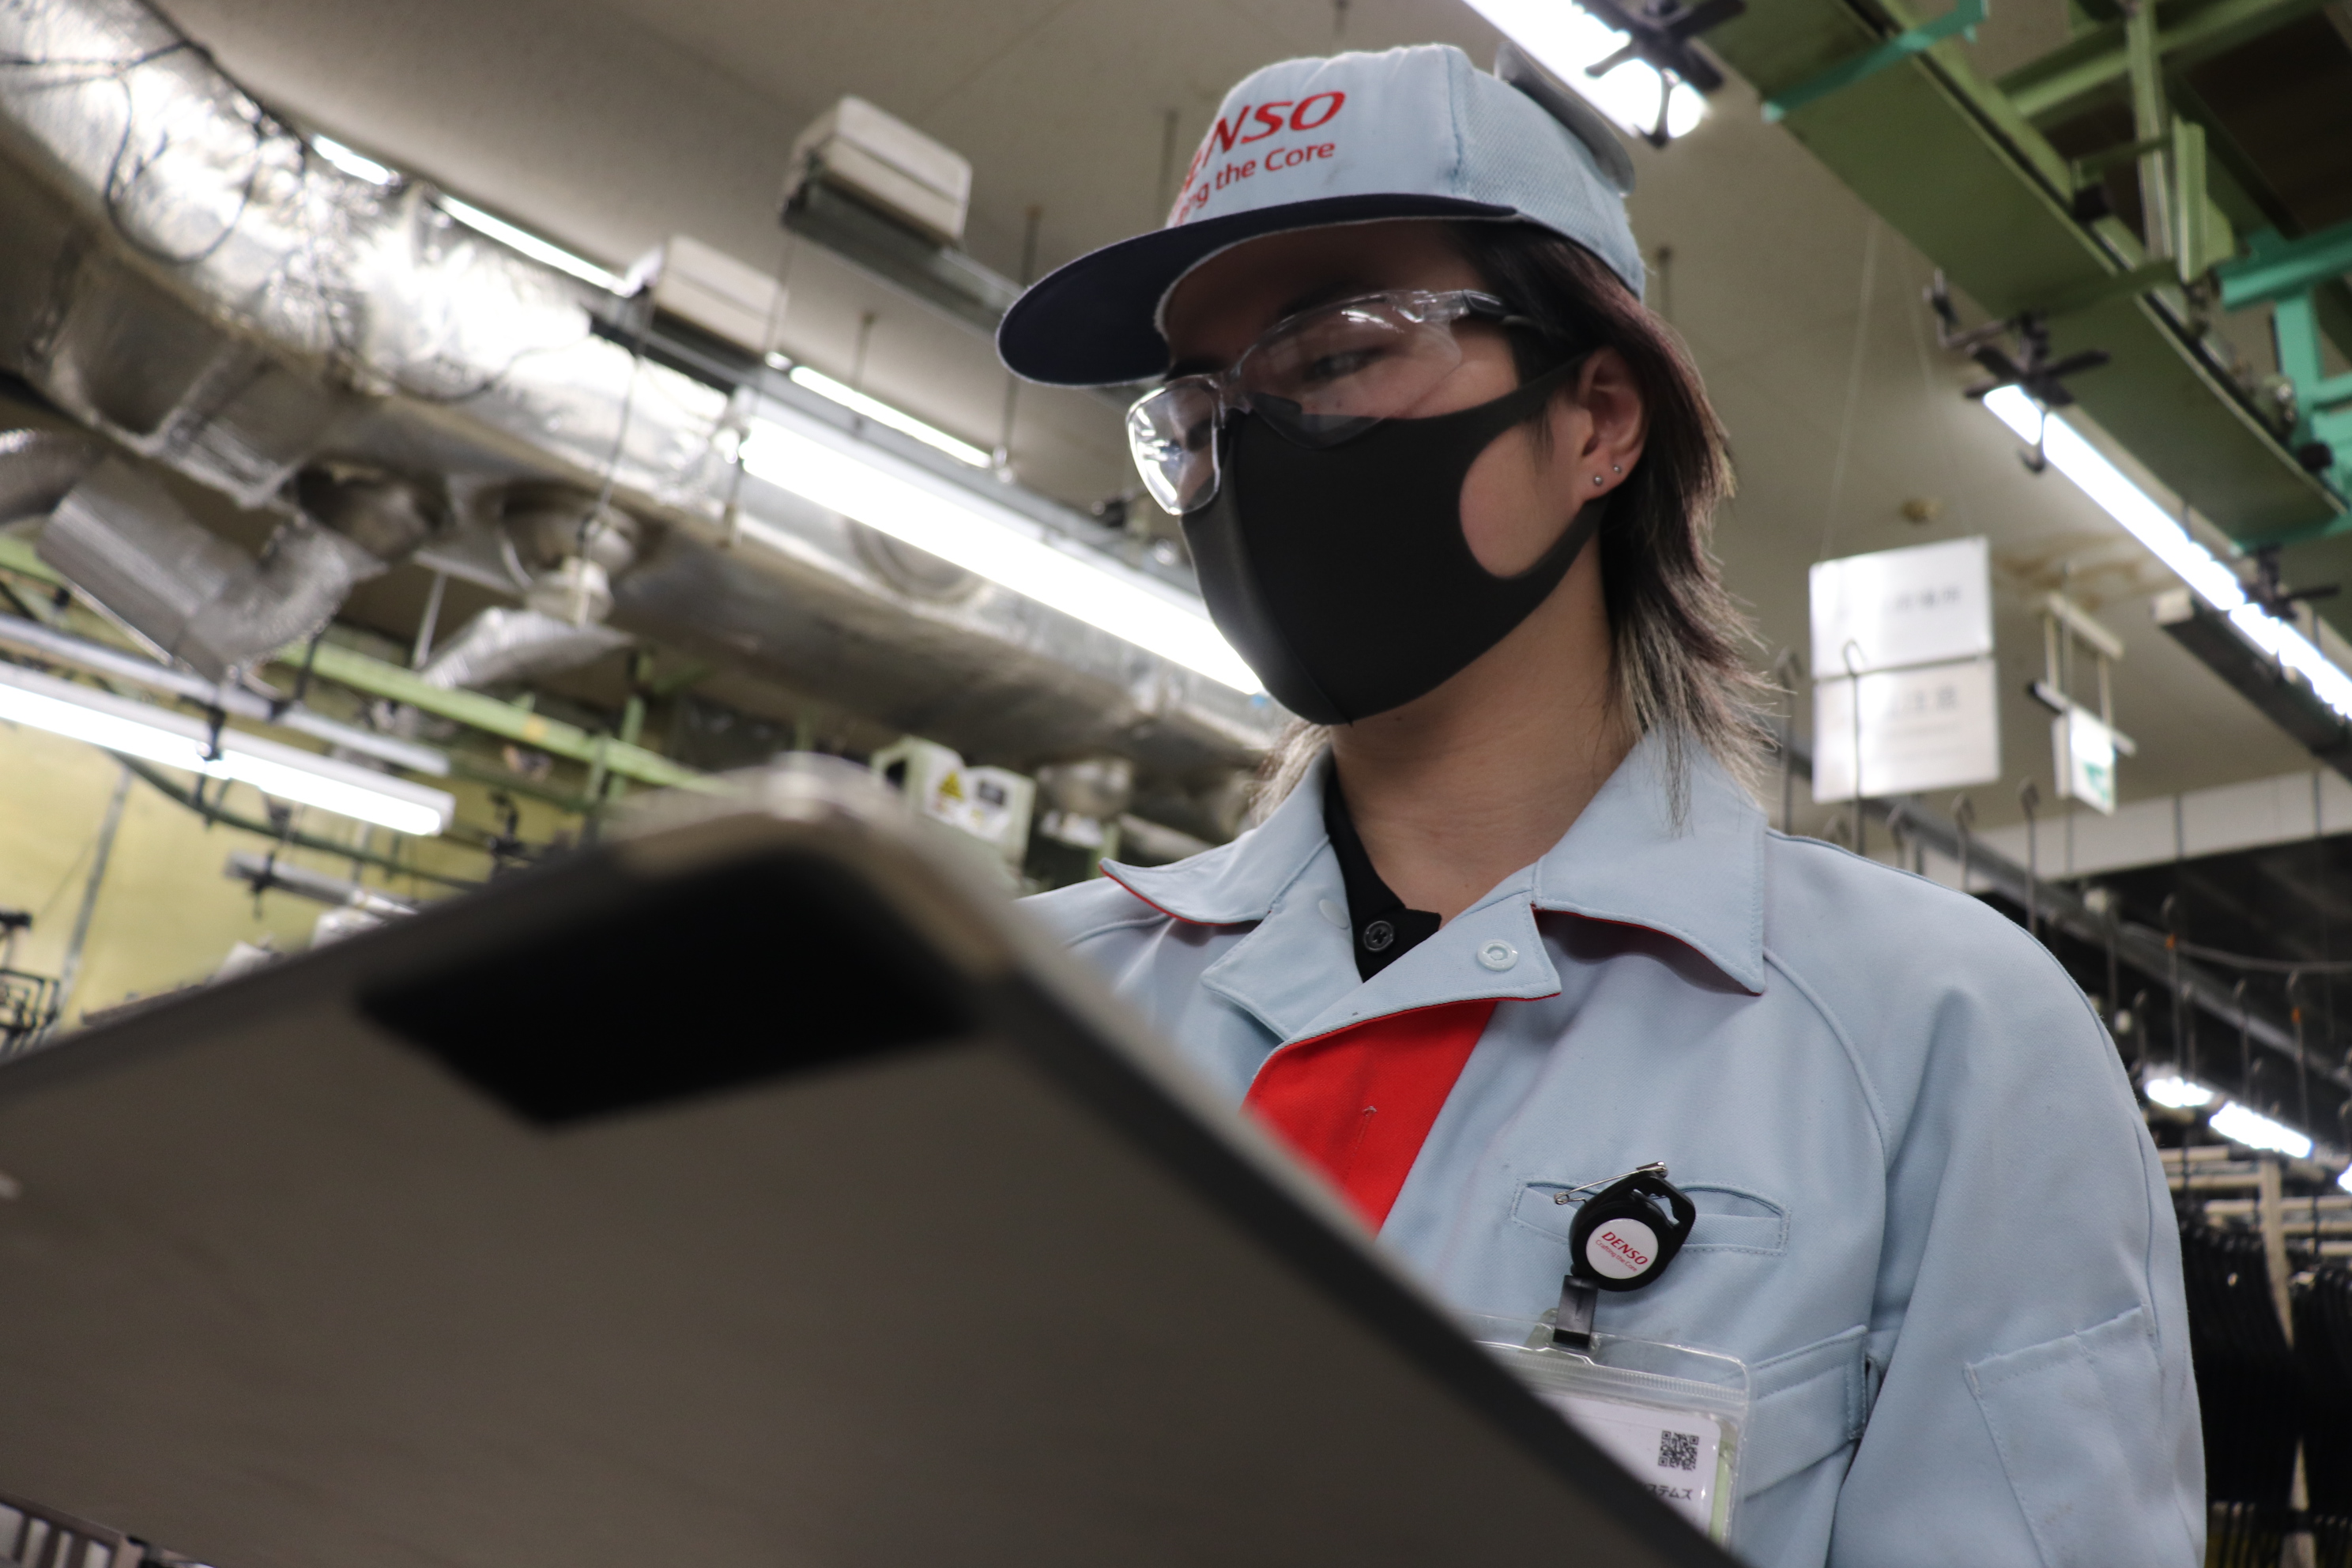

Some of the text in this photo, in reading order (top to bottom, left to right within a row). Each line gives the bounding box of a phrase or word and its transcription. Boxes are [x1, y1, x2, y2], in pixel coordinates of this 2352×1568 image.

[1216, 159, 1257, 190] the
[1265, 142, 1336, 172] Core
[1596, 1239, 1638, 1272] Crafting the Core
[1601, 1231, 1649, 1265] DENSO
